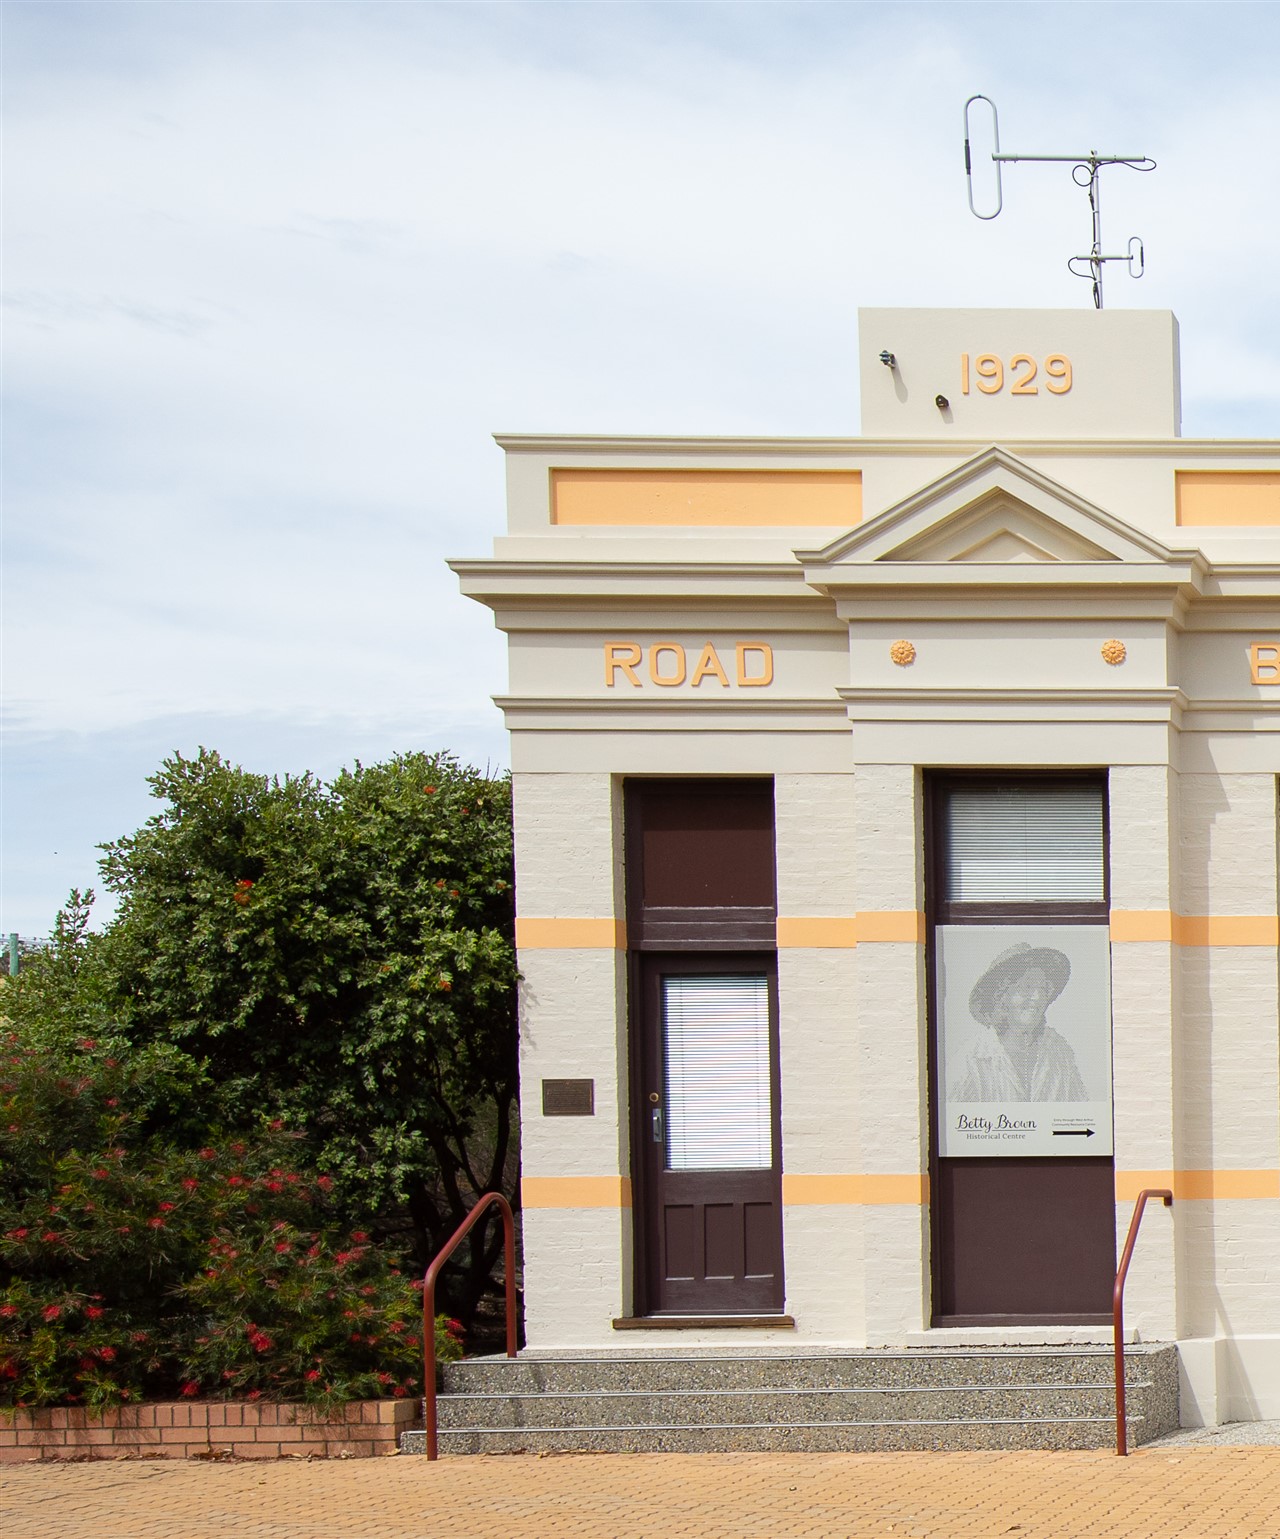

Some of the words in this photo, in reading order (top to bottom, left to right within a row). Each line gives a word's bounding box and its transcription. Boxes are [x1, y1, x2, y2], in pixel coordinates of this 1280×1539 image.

[961, 352, 1073, 395] 1929
[604, 640, 774, 687] ROAD
[955, 1113, 993, 1133] Betty
[994, 1113, 1037, 1129] Brown
